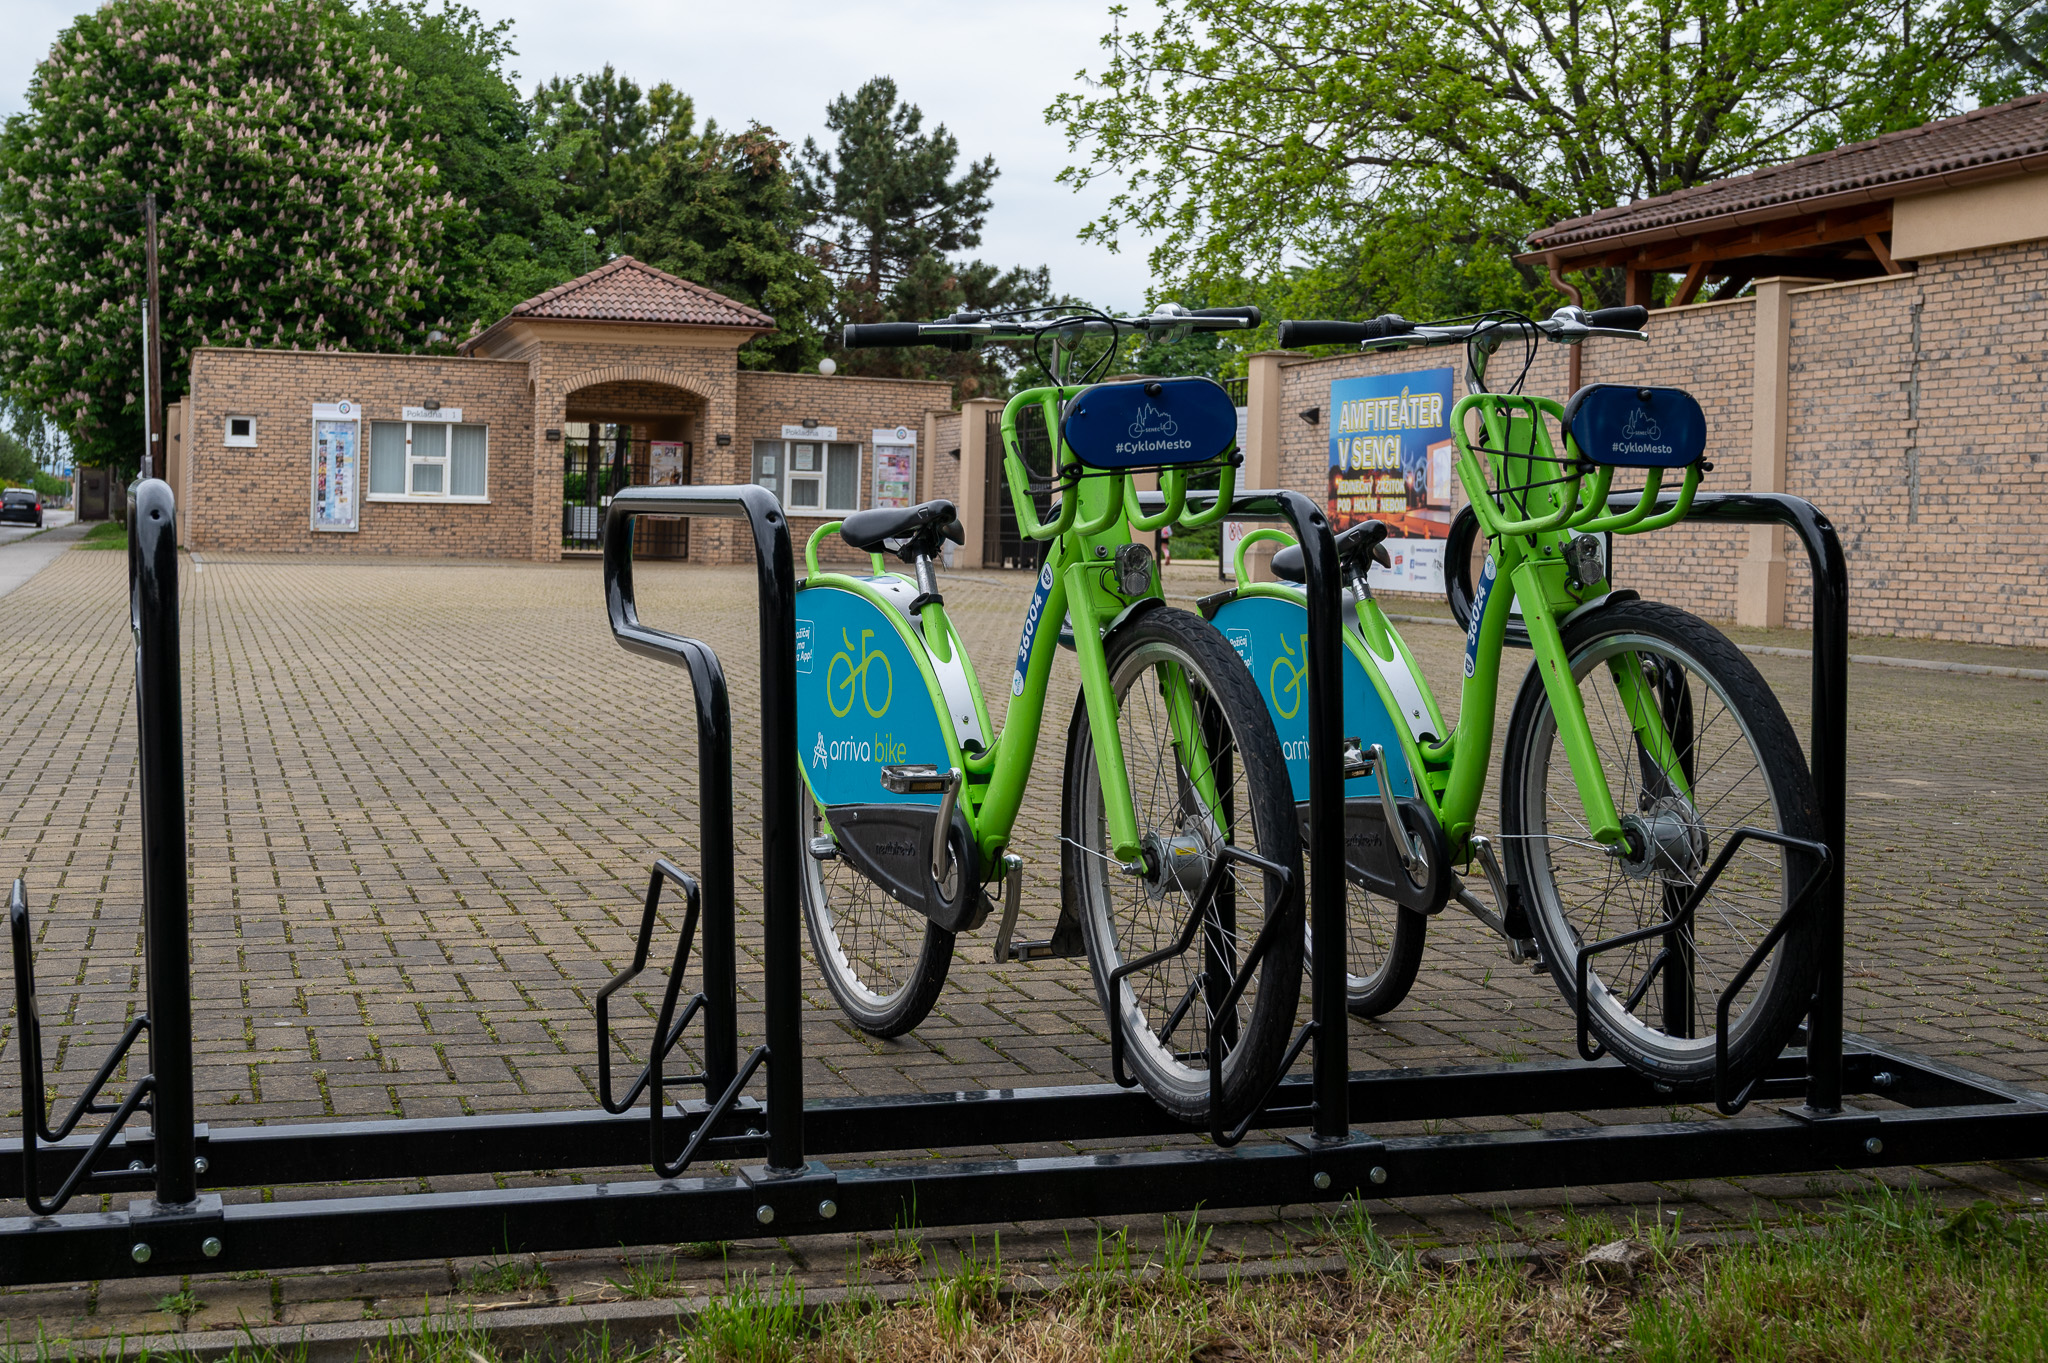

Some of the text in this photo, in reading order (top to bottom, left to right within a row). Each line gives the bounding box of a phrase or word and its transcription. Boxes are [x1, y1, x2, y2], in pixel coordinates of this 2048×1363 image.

[1338, 386, 1443, 433] AMFITEÁTER
[1115, 439, 1192, 454] #CykloMesto
[1338, 435, 1401, 470] V SENCI
[1612, 442, 1672, 454] #CykloMesto
[1337, 494, 1407, 513] POD HOLÝM NEBOM
[1019, 592, 1042, 662] 36004
[1467, 584, 1486, 646] 36024
[829, 732, 907, 763] arriva bike
[1283, 735, 1309, 760] arri
